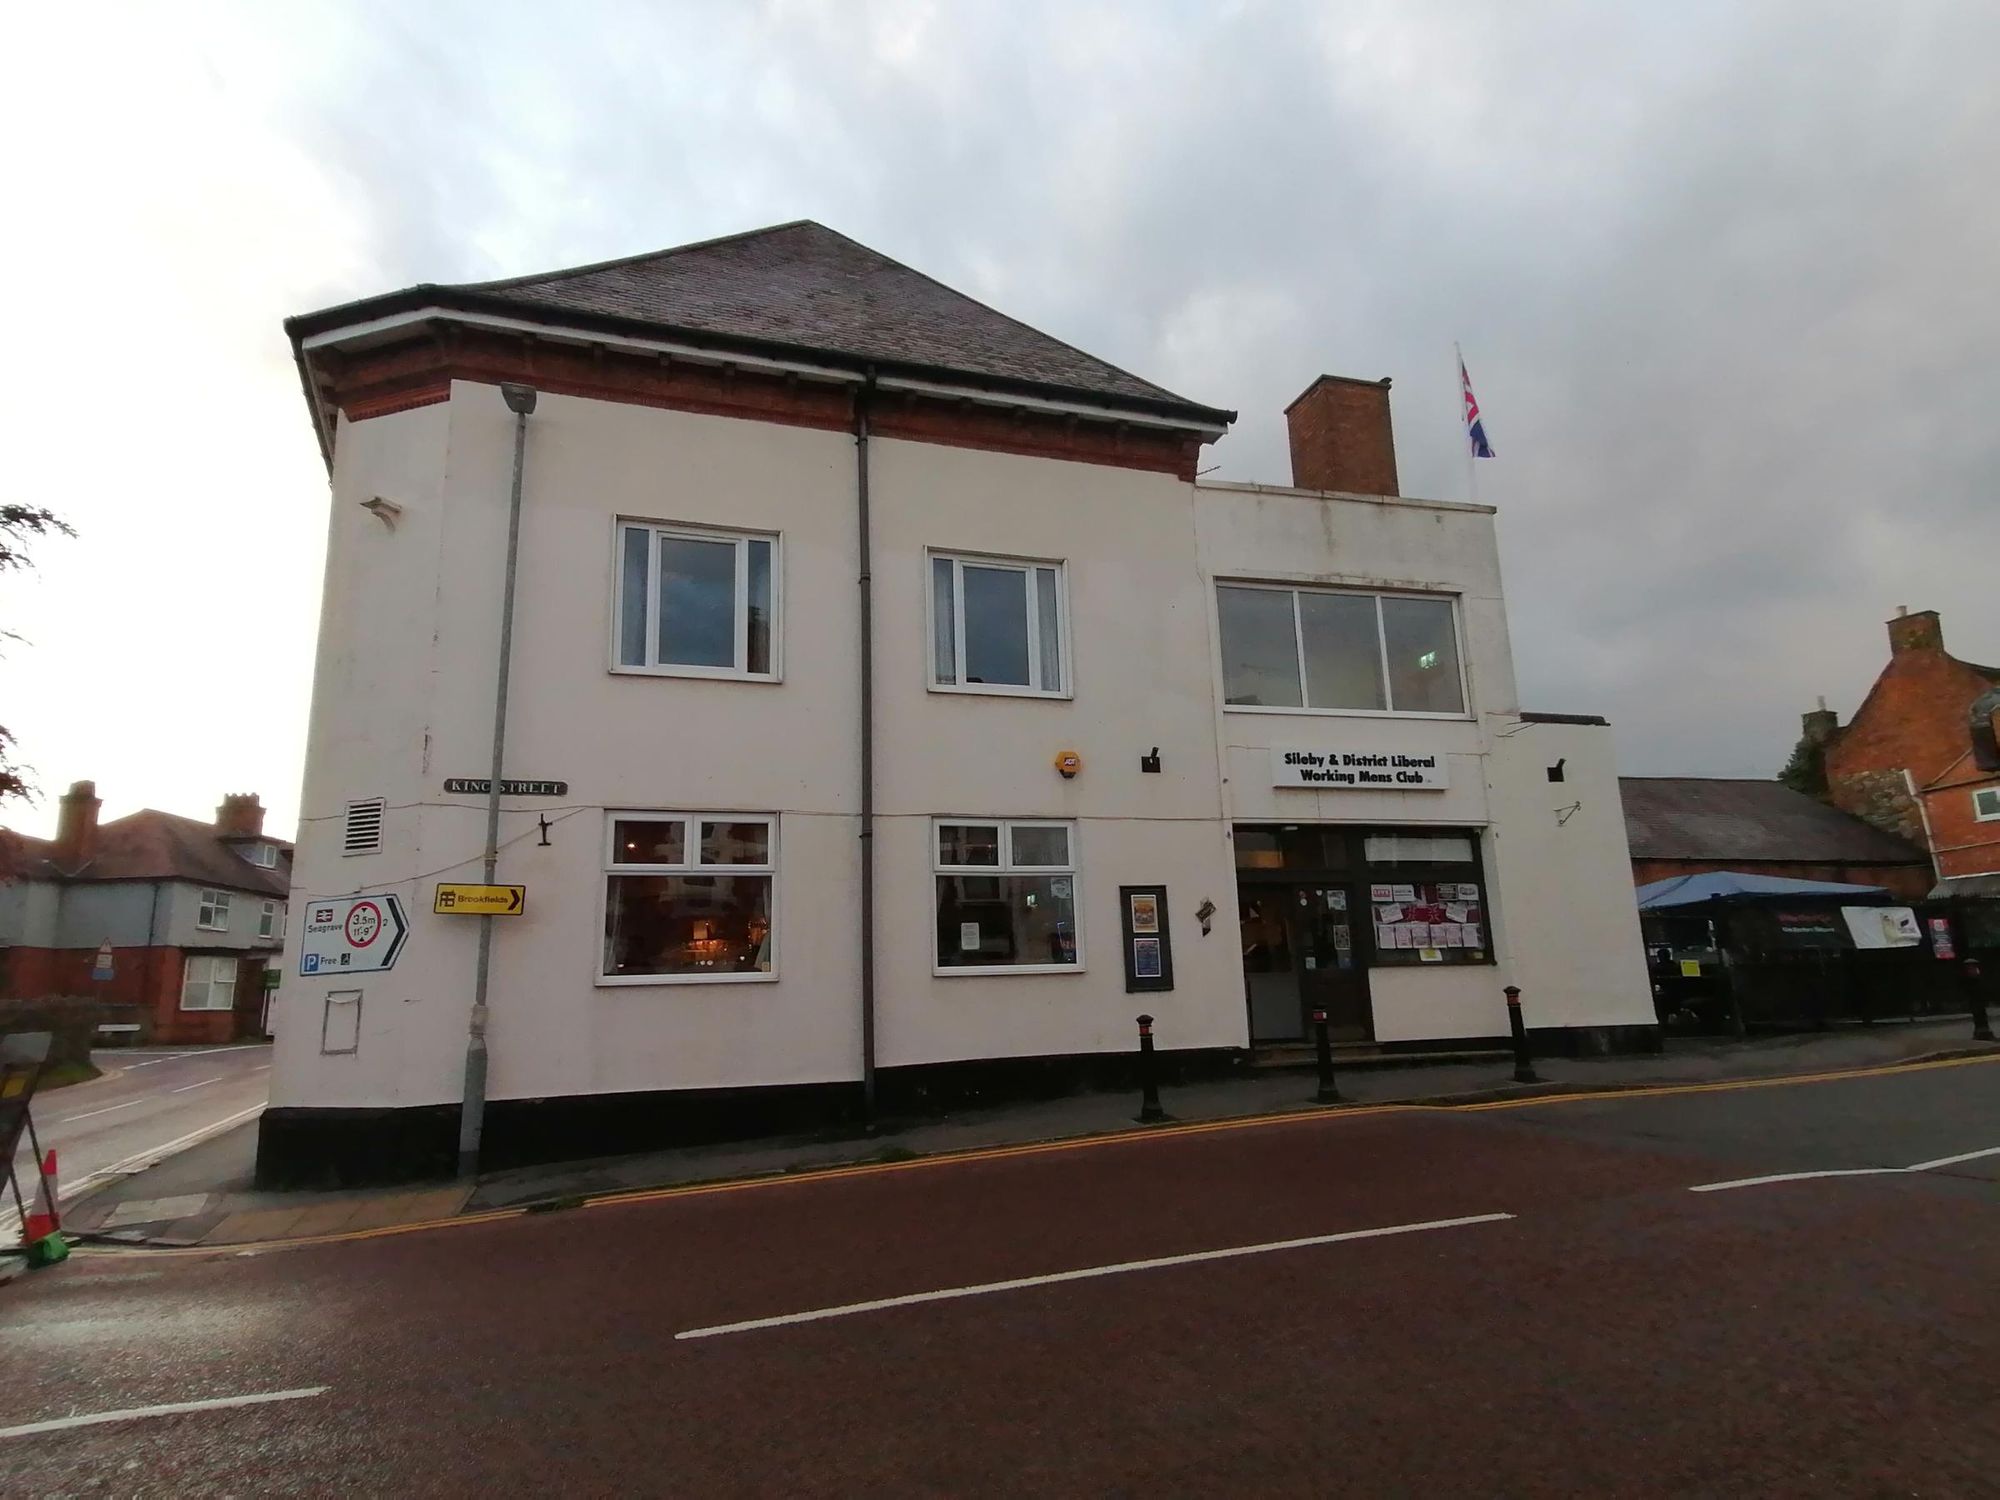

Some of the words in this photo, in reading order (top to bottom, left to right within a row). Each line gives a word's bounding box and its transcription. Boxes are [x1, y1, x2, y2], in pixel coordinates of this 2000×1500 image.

[1284, 752, 1325, 768] Sileby
[1328, 754, 1339, 766] &
[1342, 754, 1388, 767] District
[1391, 755, 1436, 768] Liberal
[1300, 769, 1355, 784] Working
[1359, 771, 1393, 783] Mens
[1396, 771, 1424, 784] Club
[458, 894, 508, 904] Brookfields
[307, 924, 343, 934] Seagrave
[383, 918, 389, 927] 2
[353, 914, 376, 925] 3.5m
[306, 955, 317, 970] P
[320, 957, 337, 965] Free
